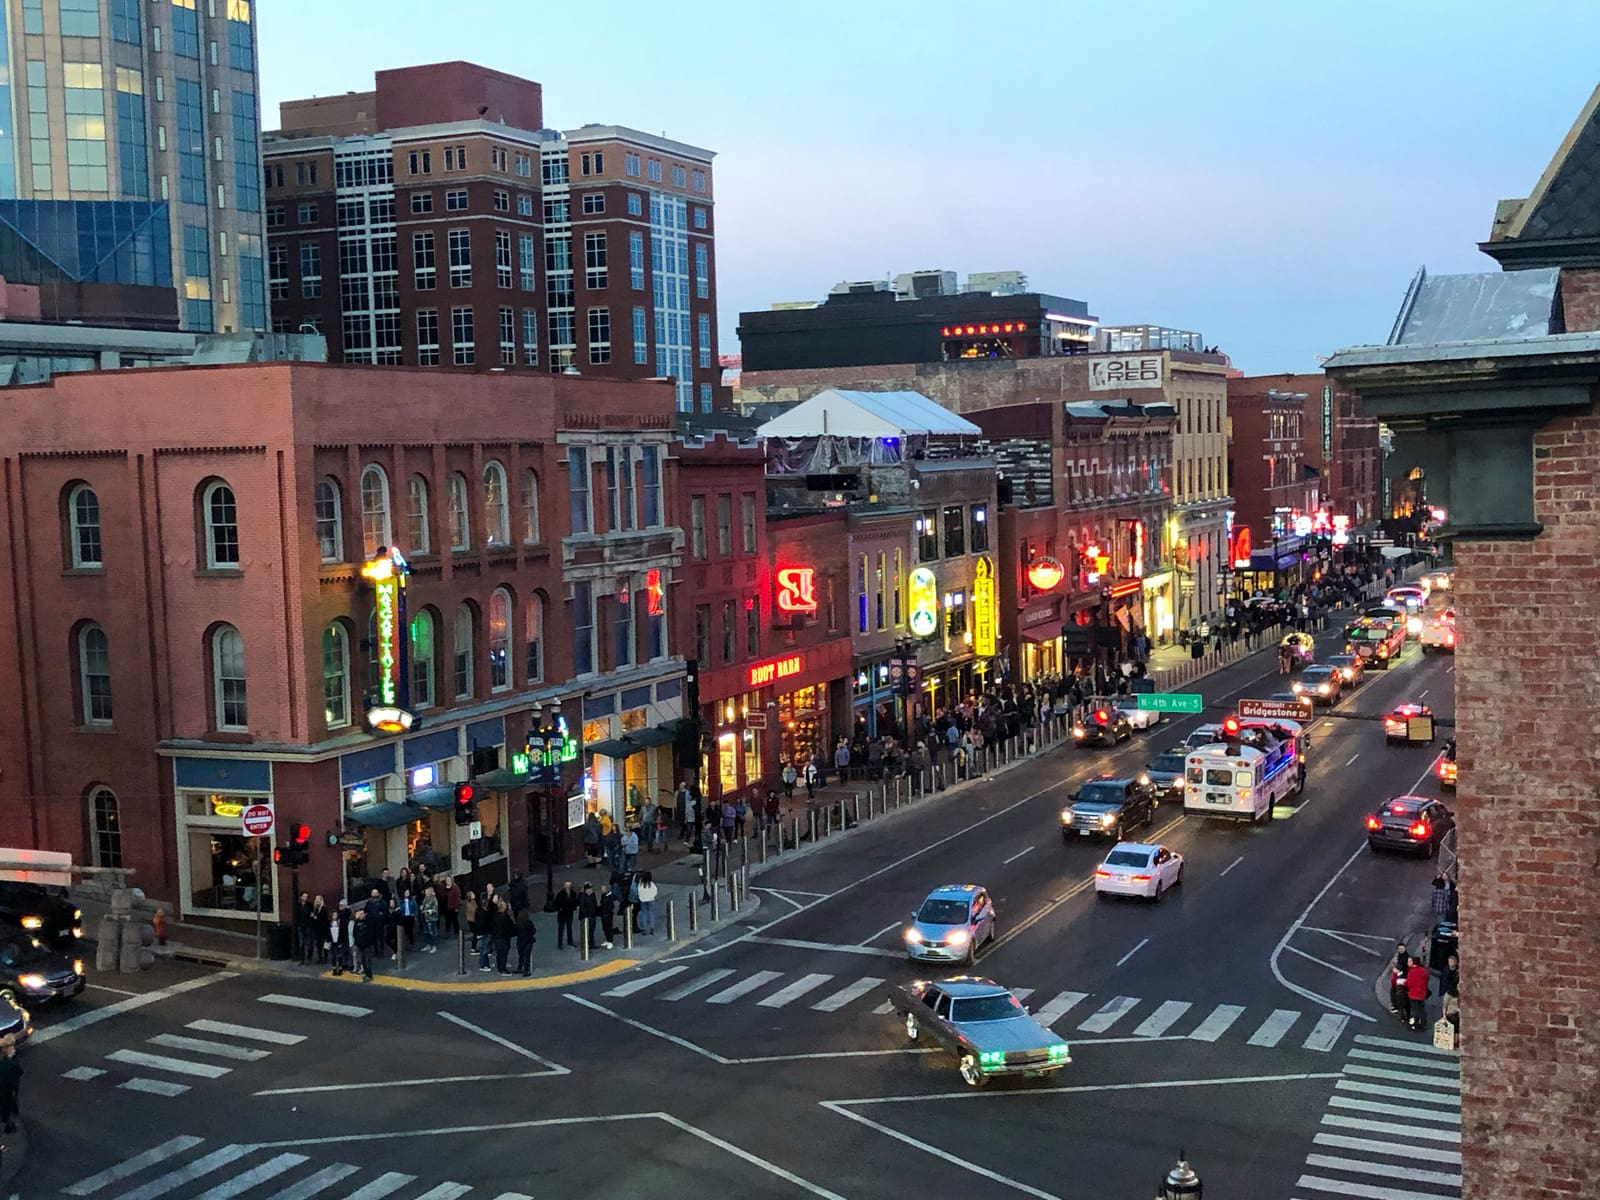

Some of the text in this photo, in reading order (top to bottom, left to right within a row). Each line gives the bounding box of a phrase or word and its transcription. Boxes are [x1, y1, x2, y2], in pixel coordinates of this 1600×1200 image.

[943, 323, 1025, 336] LOOKOUT
[1107, 360, 1157, 371] OLE
[1107, 370, 1158, 381] RED
[751, 657, 800, 685] BOOT BARN
[1152, 698, 1167, 707] 4th
[1171, 699, 1187, 708] Ave
[1243, 707, 1297, 717] Bridgestone
